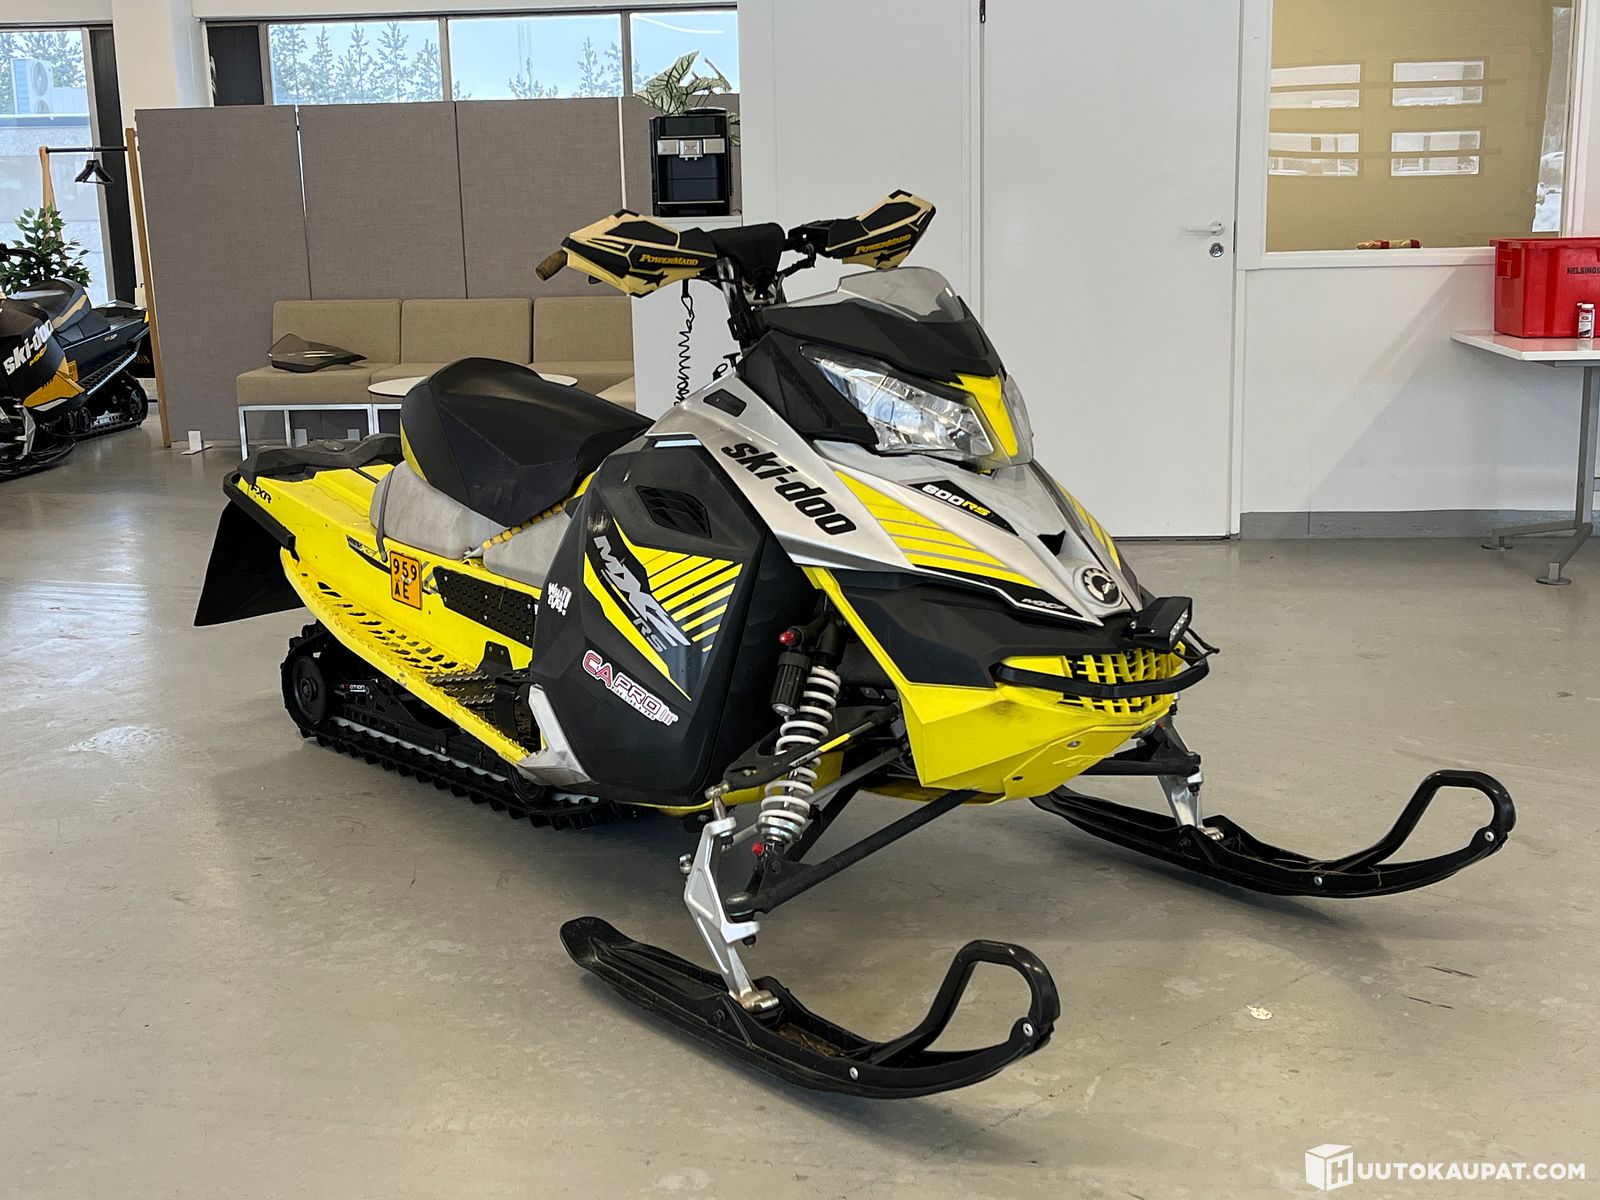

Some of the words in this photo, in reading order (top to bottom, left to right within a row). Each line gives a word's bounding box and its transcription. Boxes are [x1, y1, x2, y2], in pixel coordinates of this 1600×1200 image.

[2, 319, 54, 376] ski-doo
[251, 484, 271, 504] FXR
[721, 443, 857, 535] ski-doo
[393, 558, 417, 580] 959
[633, 617, 667, 652] RS
